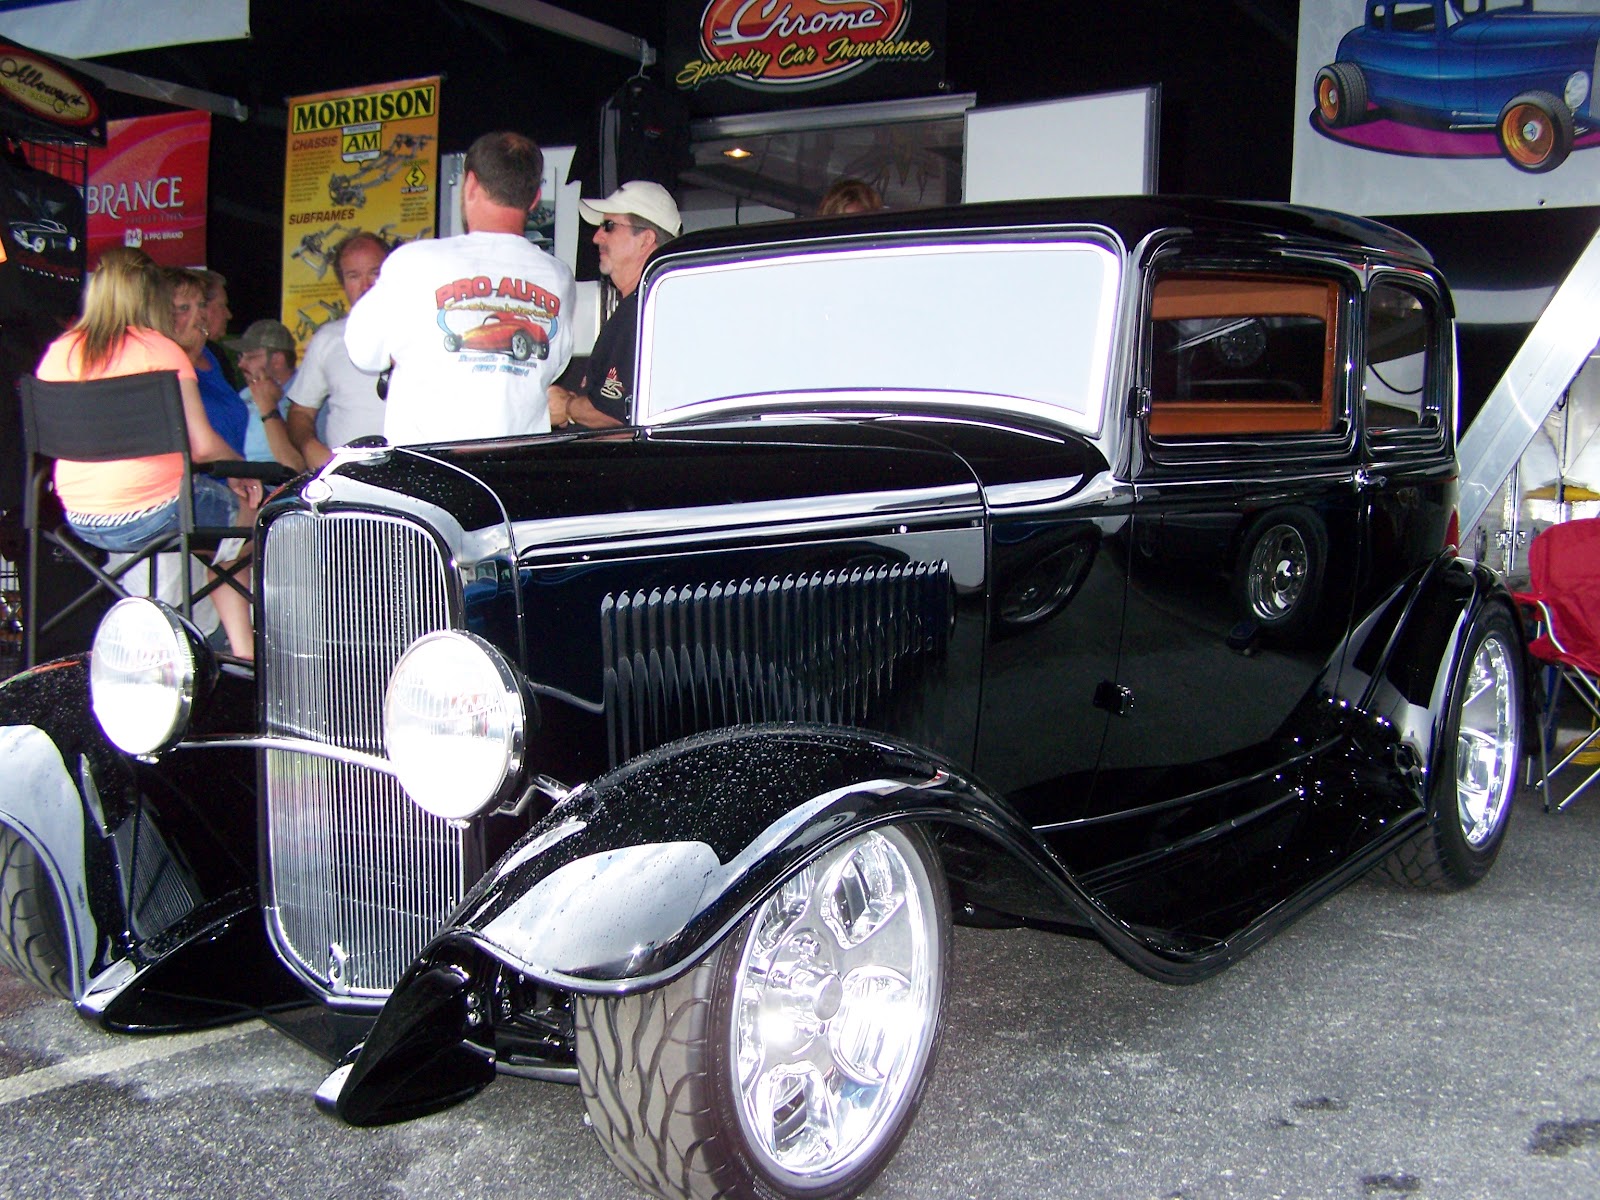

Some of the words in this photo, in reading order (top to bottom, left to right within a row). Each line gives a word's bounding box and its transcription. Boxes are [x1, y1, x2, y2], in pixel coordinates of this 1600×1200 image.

[712, 0, 883, 45] Chrome
[675, 51, 771, 85] Specialty
[778, 43, 816, 66] Car
[823, 37, 932, 63] Insurance
[295, 87, 434, 132] MORRISON
[292, 135, 338, 151] CHASSIS
[345, 133, 379, 152] AM
[79, 176, 185, 220] BRANCE
[288, 208, 355, 225] SUBFRAMES
